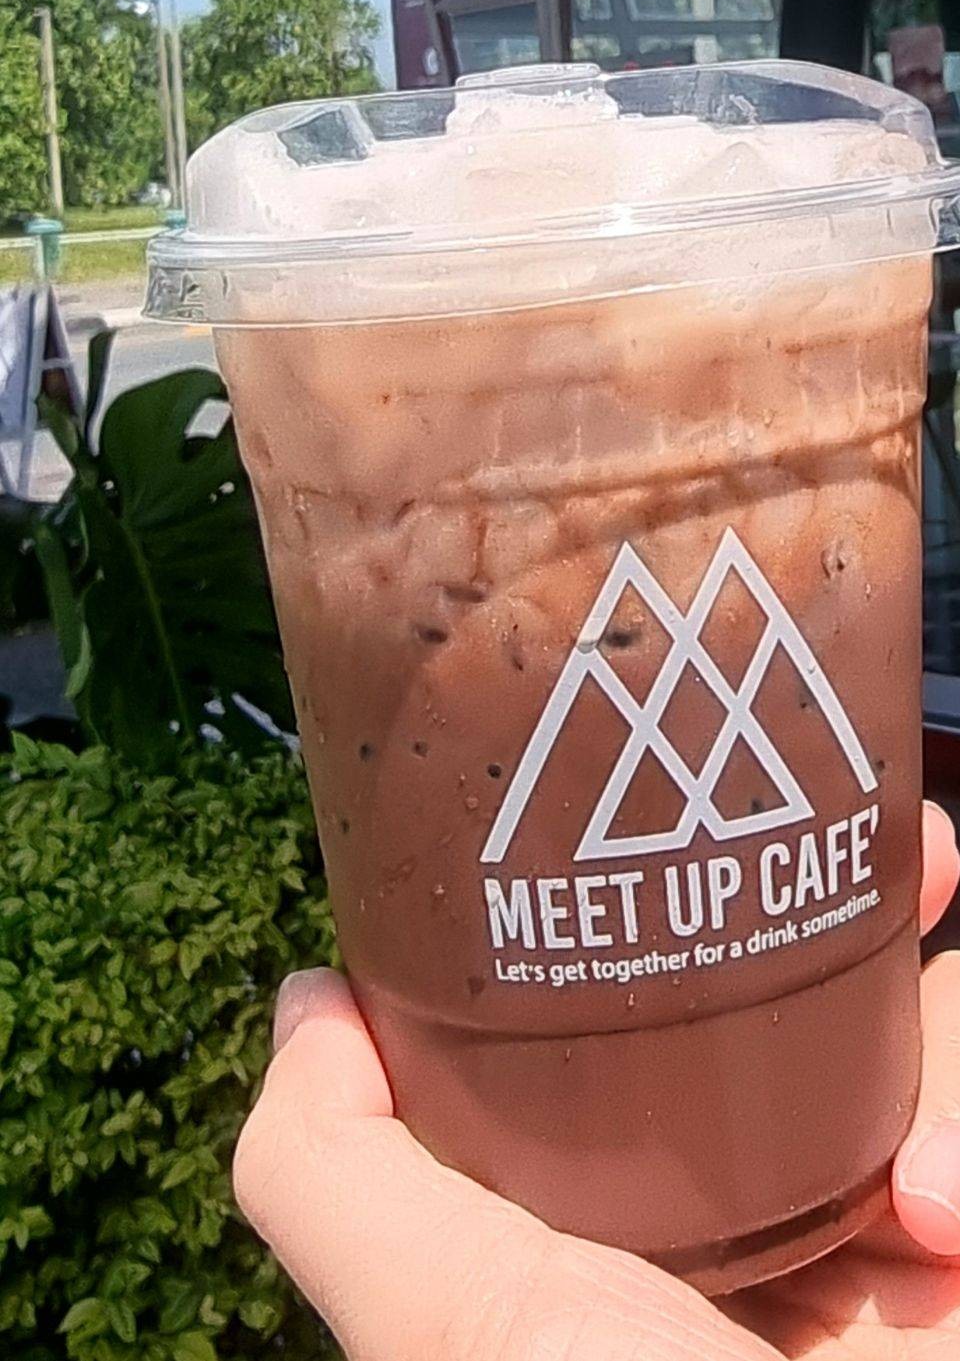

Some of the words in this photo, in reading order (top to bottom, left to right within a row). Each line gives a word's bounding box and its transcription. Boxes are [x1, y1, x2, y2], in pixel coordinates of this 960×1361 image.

[484, 871, 644, 950] MEET
[664, 855, 743, 937] UP
[759, 803, 879, 917] CAFE'
[494, 958, 546, 983] Let's
[549, 959, 589, 988] get
[590, 950, 691, 984] together
[693, 942, 726, 968] for
[729, 940, 743, 960] a
[746, 919, 799, 955] drink
[800, 888, 882, 939] sometime.
